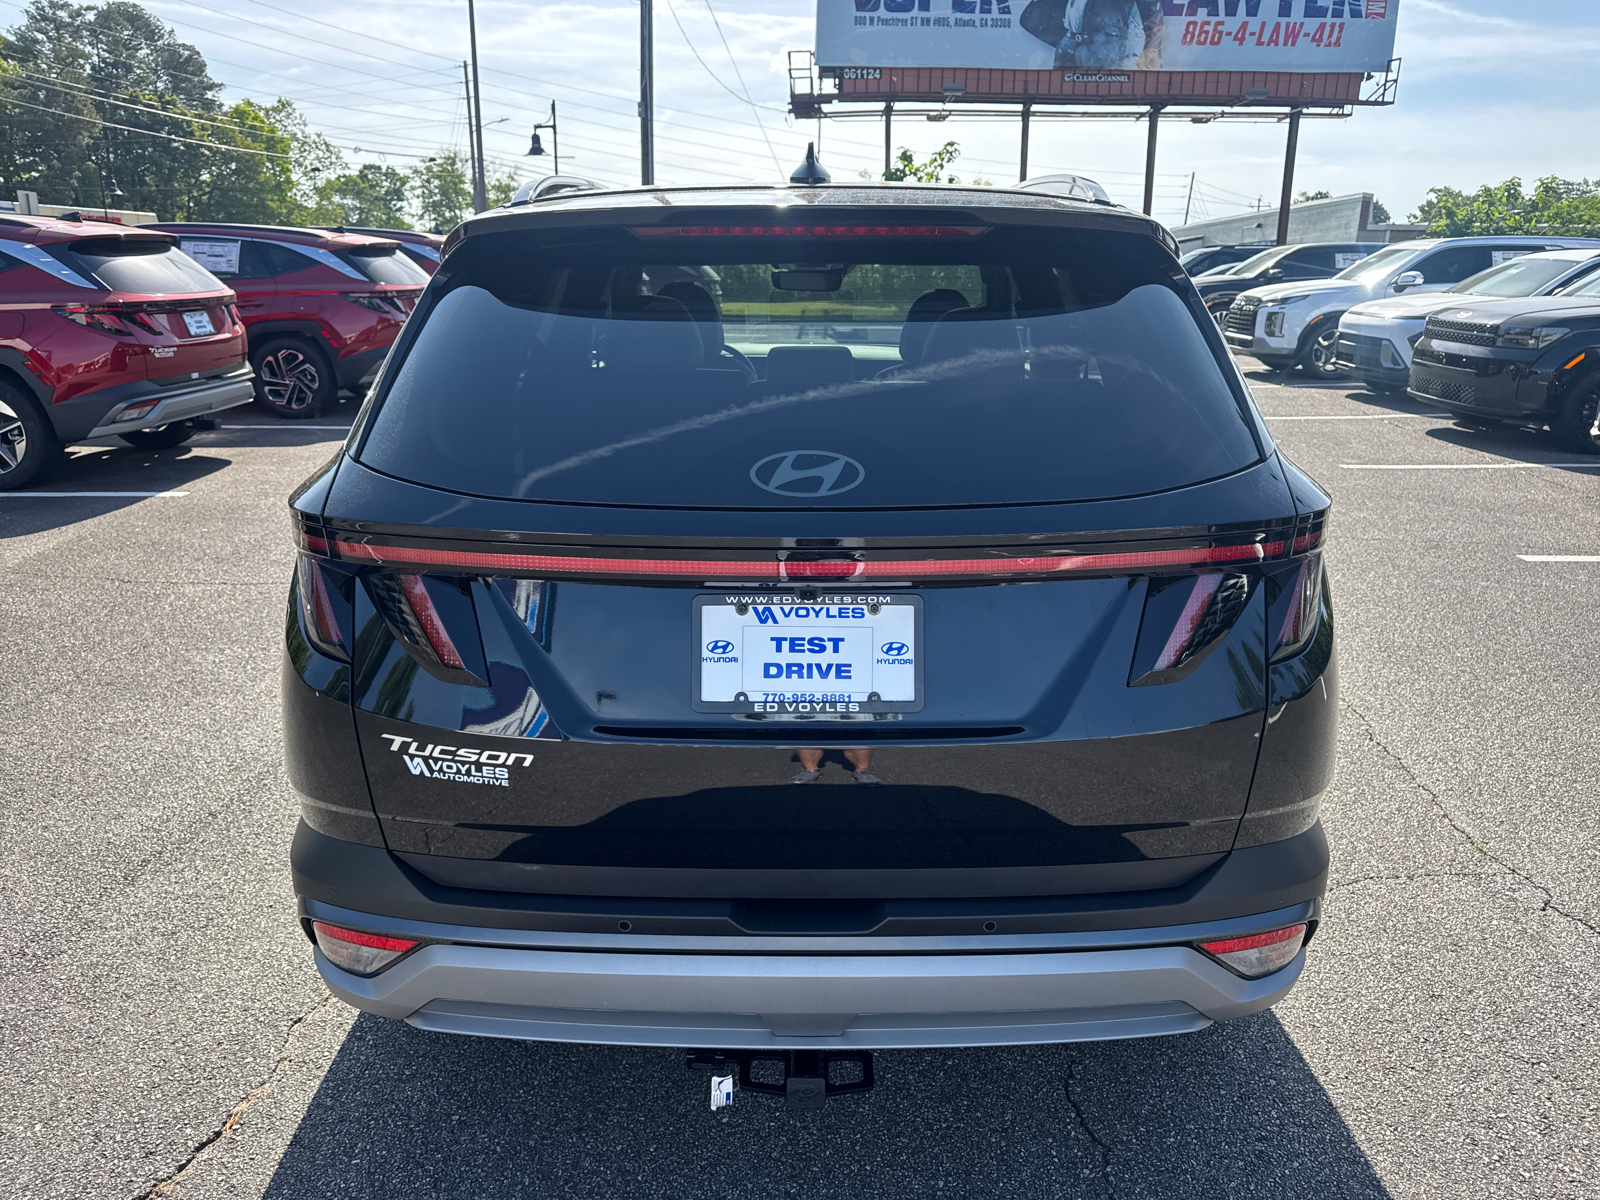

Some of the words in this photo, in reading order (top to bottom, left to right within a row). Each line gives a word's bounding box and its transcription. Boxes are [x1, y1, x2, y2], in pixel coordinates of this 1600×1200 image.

[869, 16, 875, 26] W
[877, 16, 908, 27] Peachtree
[910, 16, 919, 27] ST
[920, 17, 931, 27] NW
[954, 17, 978, 29] Atlanta,
[979, 18, 988, 28] GA
[990, 18, 1012, 29] 30308
[1181, 20, 1346, 47] 866-4-LAW-411
[843, 68, 881, 79] 061124
[725, 596, 891, 604] WWW.EDVYLES.COM
[779, 606, 865, 619] VOYLES
[770, 636, 845, 654] TEST
[763, 662, 853, 680] DRIVE
[762, 693, 852, 702] 770-952-8881
[754, 702, 778, 712] ED
[784, 702, 860, 712] VOYLES
[428, 758, 509, 779] VOYLES
[432, 770, 510, 787] AUTOMOTIVE
